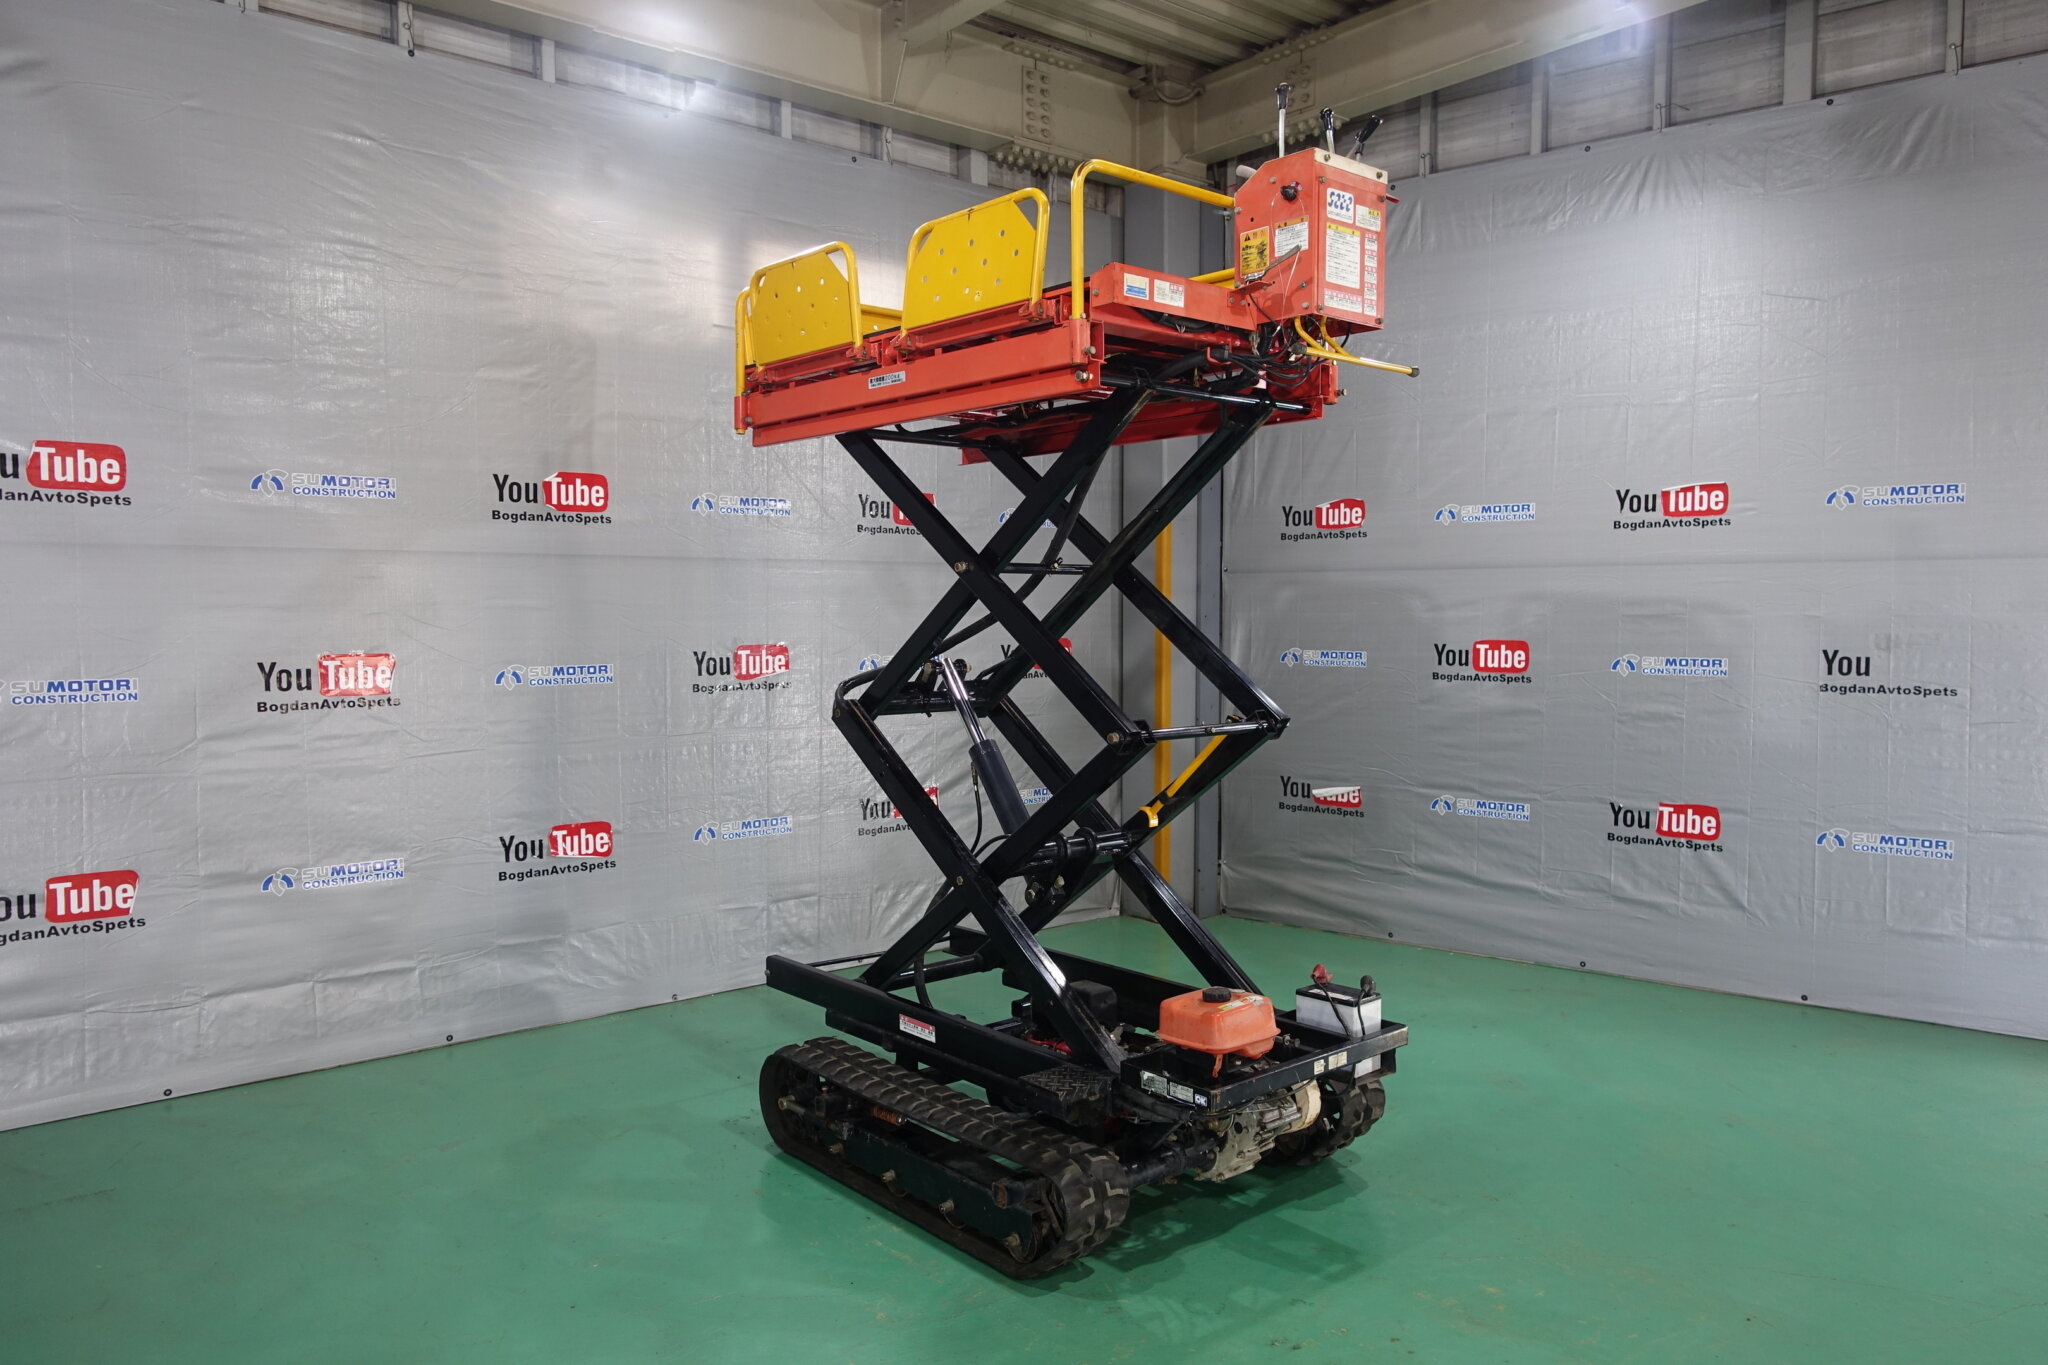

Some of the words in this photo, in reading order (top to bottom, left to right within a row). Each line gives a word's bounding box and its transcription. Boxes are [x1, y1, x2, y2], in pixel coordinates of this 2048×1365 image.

[292, 486, 396, 499] CONSTRUCTION
[1863, 493, 1965, 507] CONSTRUCTION
[720, 506, 791, 517] CONSTRUCTION
[858, 494, 890, 520] You
[491, 510, 612, 525] BogdanAvtoSpets
[1462, 512, 1535, 523] CONSTRUCTION
[1613, 517, 1732, 531] BogdanAvtoSpets
[1280, 530, 1368, 542] BogdanAvtoSpets
[1303, 658, 1367, 668] CONSTRUCTION
[1822, 649, 1870, 677] You
[1432, 672, 1532, 685] BogdanAvtoSpets
[1642, 665, 1728, 677] CONSTRUCTION
[529, 675, 613, 687] CONSTRUCTION
[12, 691, 138, 705] CONSTRUCTION
[1819, 683, 1958, 698] BogdanAvtoSpets
[256, 697, 401, 714] BogdanAvtoSpets
[1278, 802, 1365, 818] BogdanAvtoSpets
[1457, 807, 1530, 821] CONSTRUCTION
[721, 825, 792, 841] CONSTRUCTION
[1607, 832, 1724, 853] BogdanAvtoSpets
[1853, 843, 1953, 861] CONSTRUCTION
[498, 859, 617, 882] BogdanAvtoSpets
[302, 869, 404, 890] CONSTRUCTION
[0, 893, 36, 922] ou
[0, 917, 146, 947] gdanAvtoSpets
